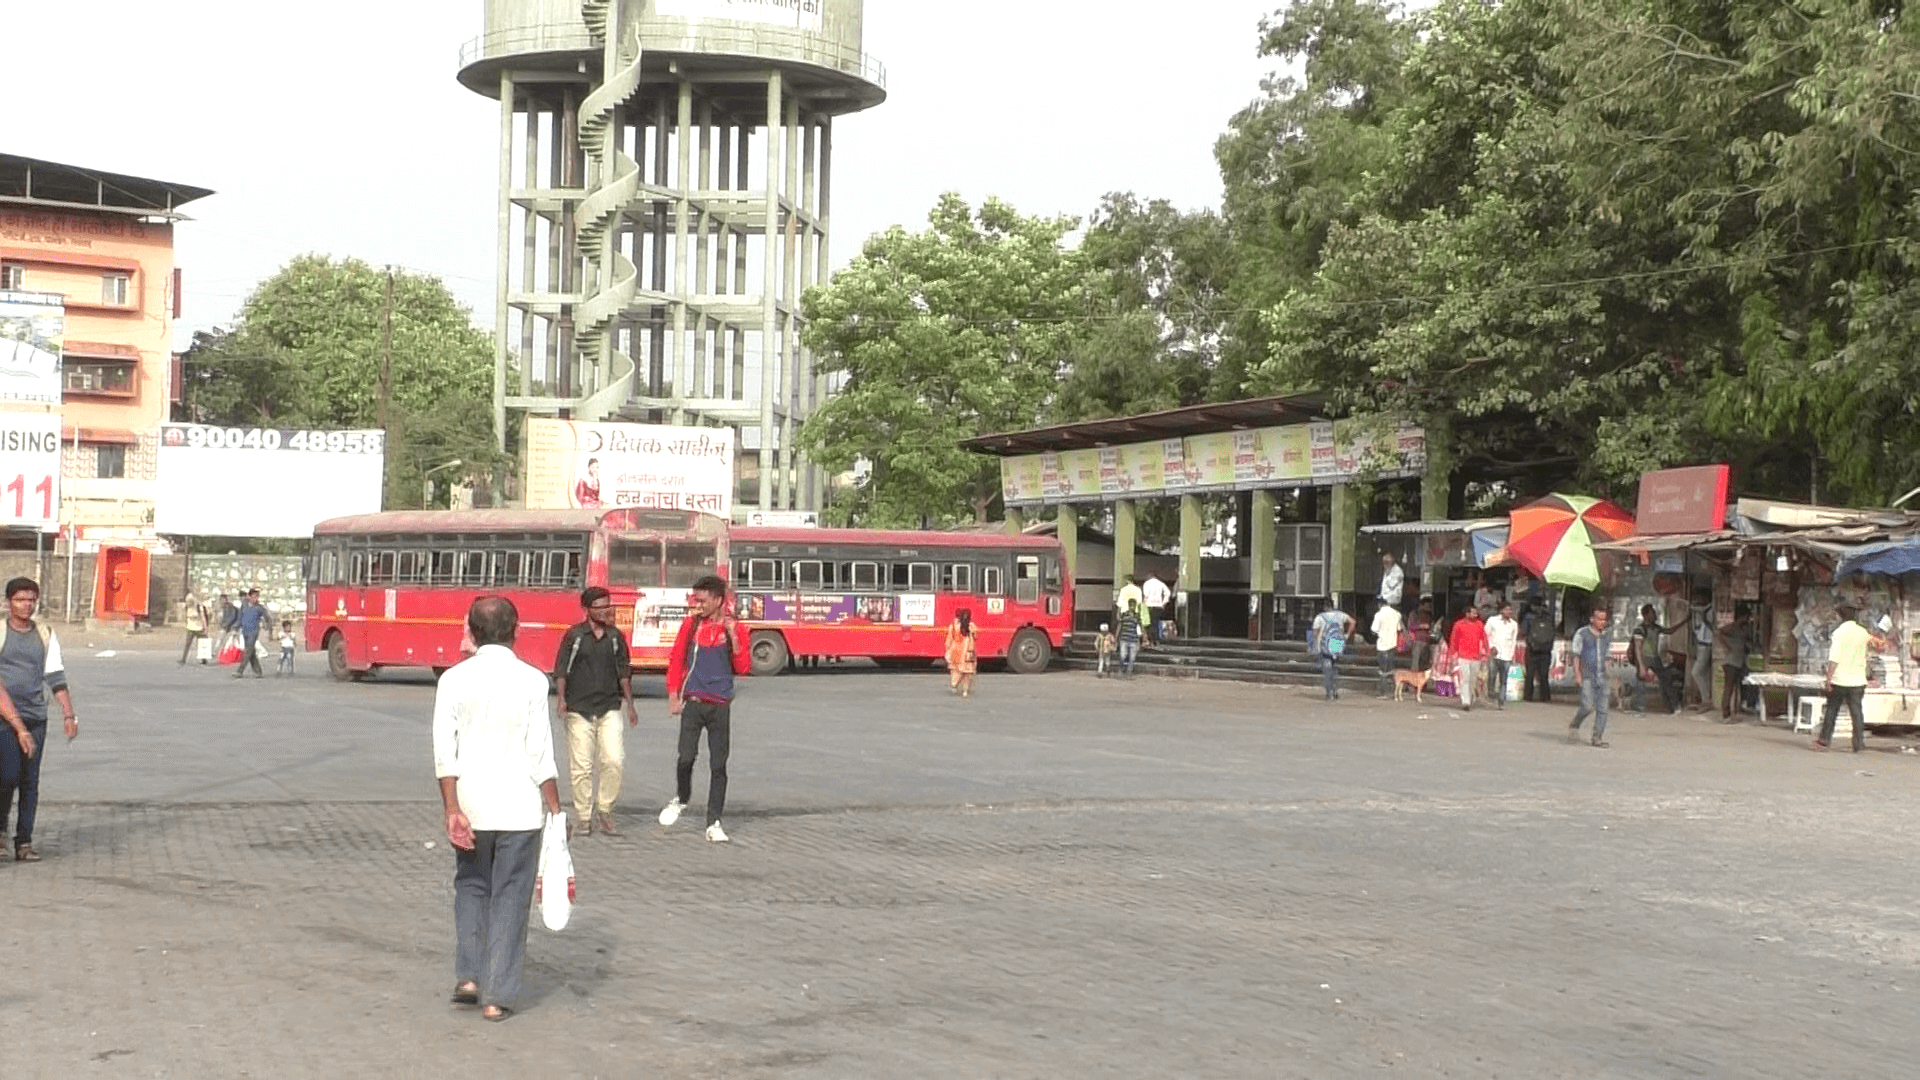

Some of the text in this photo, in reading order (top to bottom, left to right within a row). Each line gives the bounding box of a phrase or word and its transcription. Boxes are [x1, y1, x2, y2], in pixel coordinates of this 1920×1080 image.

[1, 430, 57, 453] ISING
[187, 427, 382, 454] 90040 48958
[0, 473, 53, 519] 11
